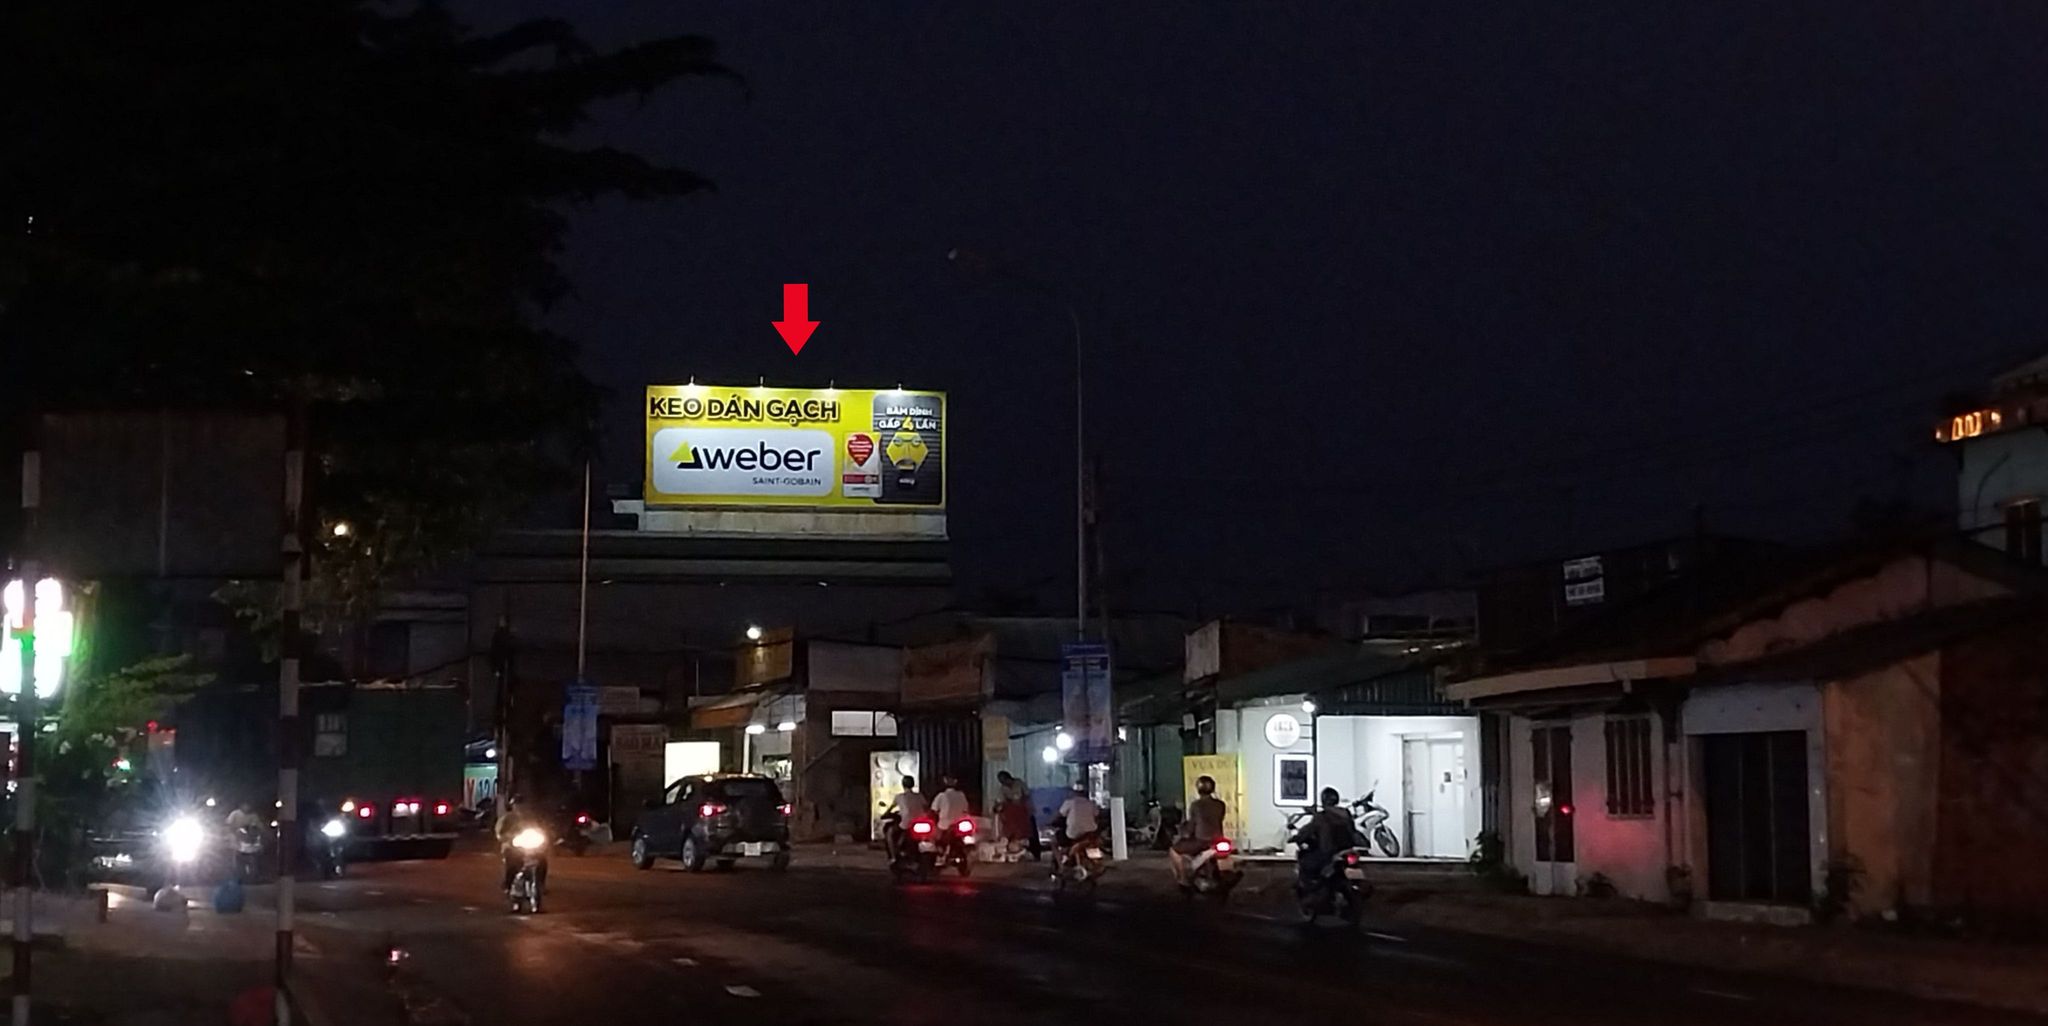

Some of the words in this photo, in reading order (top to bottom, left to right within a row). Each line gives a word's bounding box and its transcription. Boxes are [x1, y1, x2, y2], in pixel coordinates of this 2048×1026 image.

[650, 396, 702, 417] KEO
[767, 398, 839, 426] GẠCH
[902, 416, 914, 431] 4
[702, 441, 821, 471] weber
[752, 477, 821, 486] SAINT-GOBAIN
